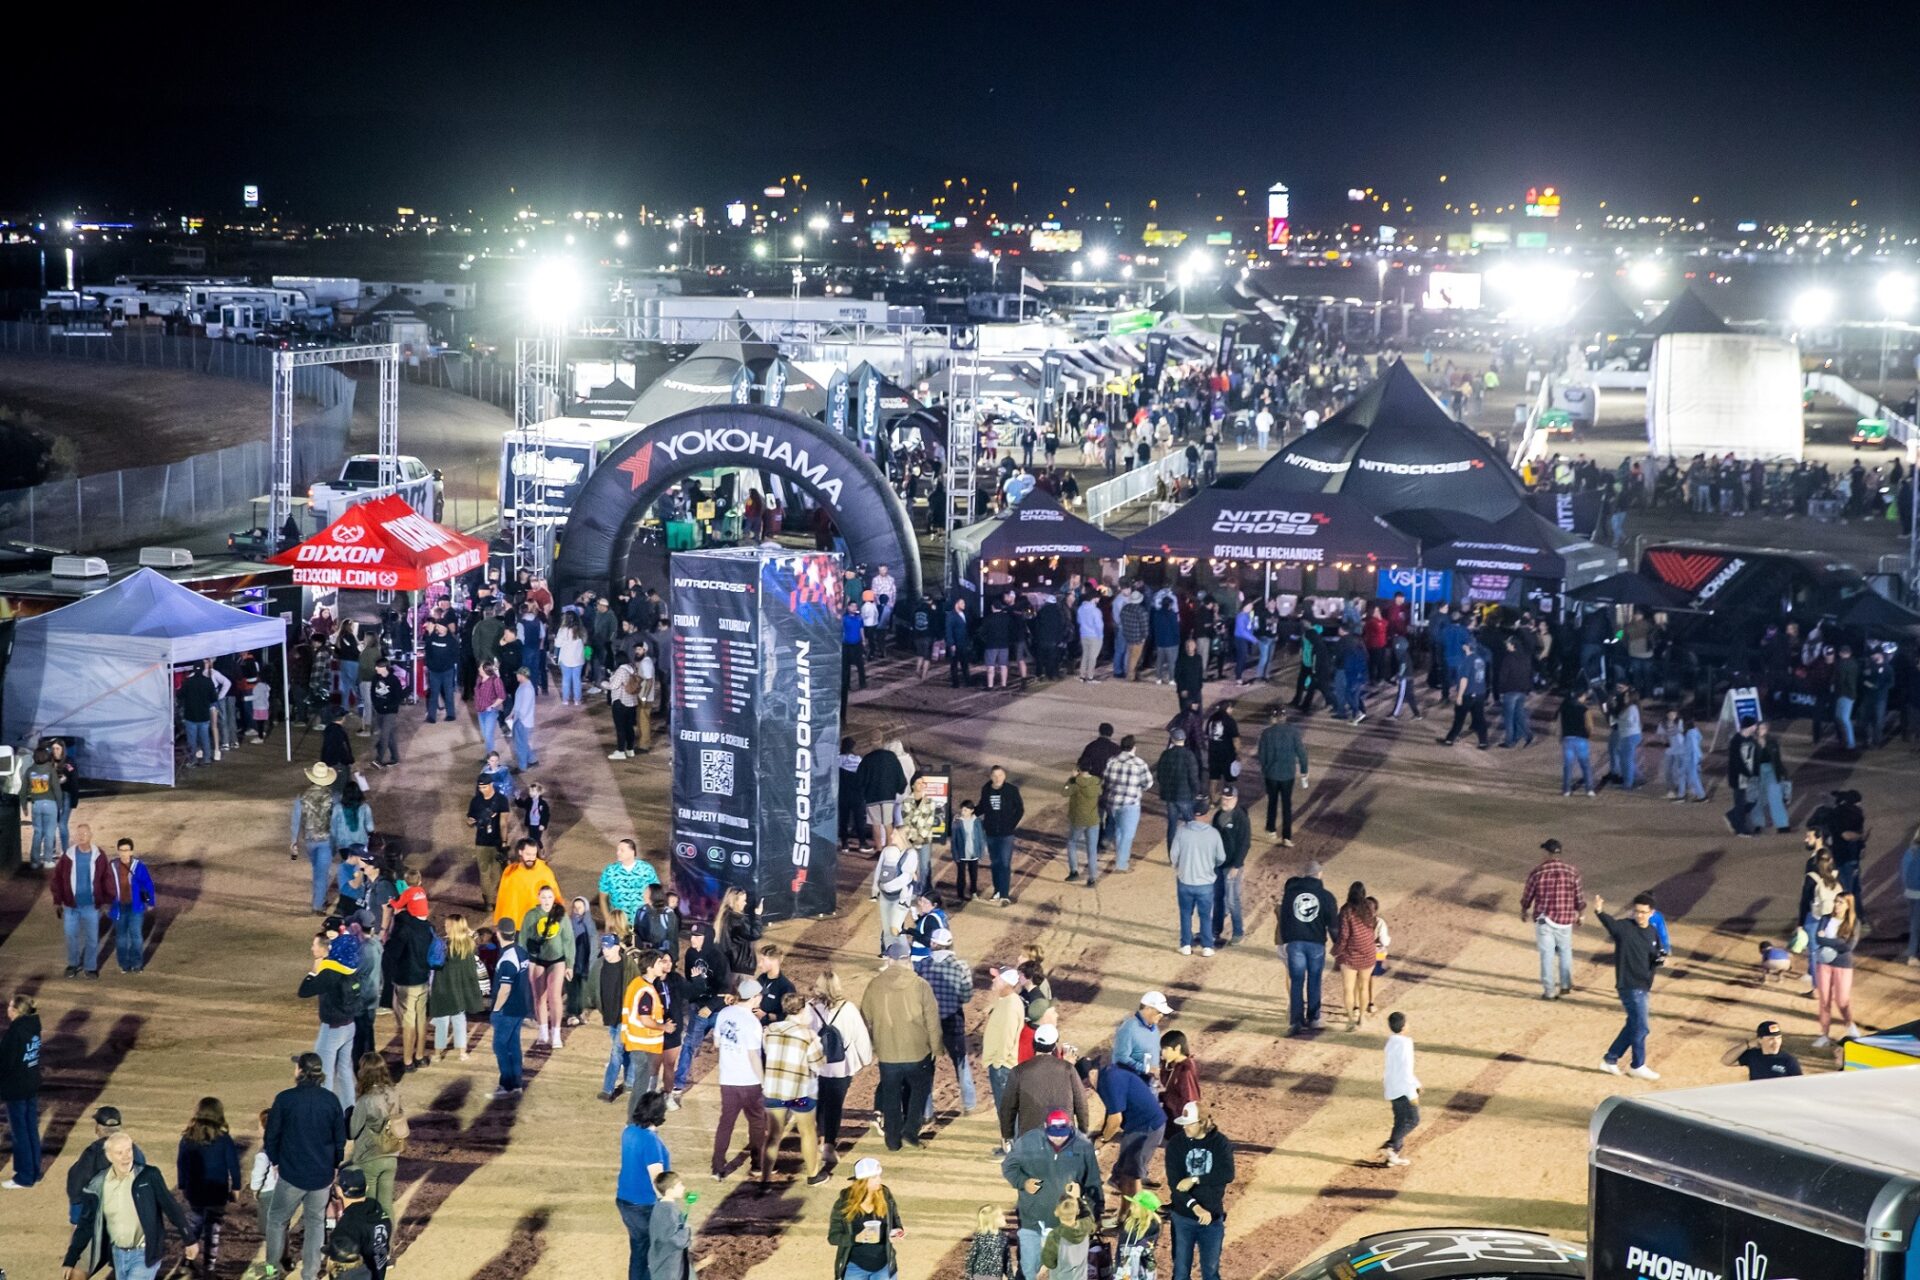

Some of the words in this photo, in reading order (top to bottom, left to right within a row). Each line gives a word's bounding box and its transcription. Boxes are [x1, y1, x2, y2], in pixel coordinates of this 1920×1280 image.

[656, 428, 844, 506] YOKOHAMA
[1358, 458, 1471, 475] NITROCROSS
[1217, 509, 1312, 524] NITRO
[1211, 522, 1319, 535] CROSS
[296, 545, 385, 564] DIXXON
[1015, 544, 1084, 553] NITROCROSS
[1213, 545, 1256, 558] OFFICIAL
[1256, 545, 1325, 561] MERCHANDISE
[1452, 541, 1540, 554] NITROCROSS
[1456, 559, 1525, 571] NITROCROSS
[293, 568, 378, 586] DIXXON.COM
[674, 578, 747, 593] NITROCROSS
[673, 614, 700, 627] FRIDAY
[718, 618, 751, 633] SATURDAY
[680, 729, 701, 741] EVENT
[701, 731, 720, 743] MAP
[792, 639, 811, 868] NITROCROSS
[679, 807, 691, 819] FAN
[691, 810, 717, 823] SAFETY
[1369, 1234, 1570, 1273] 23
